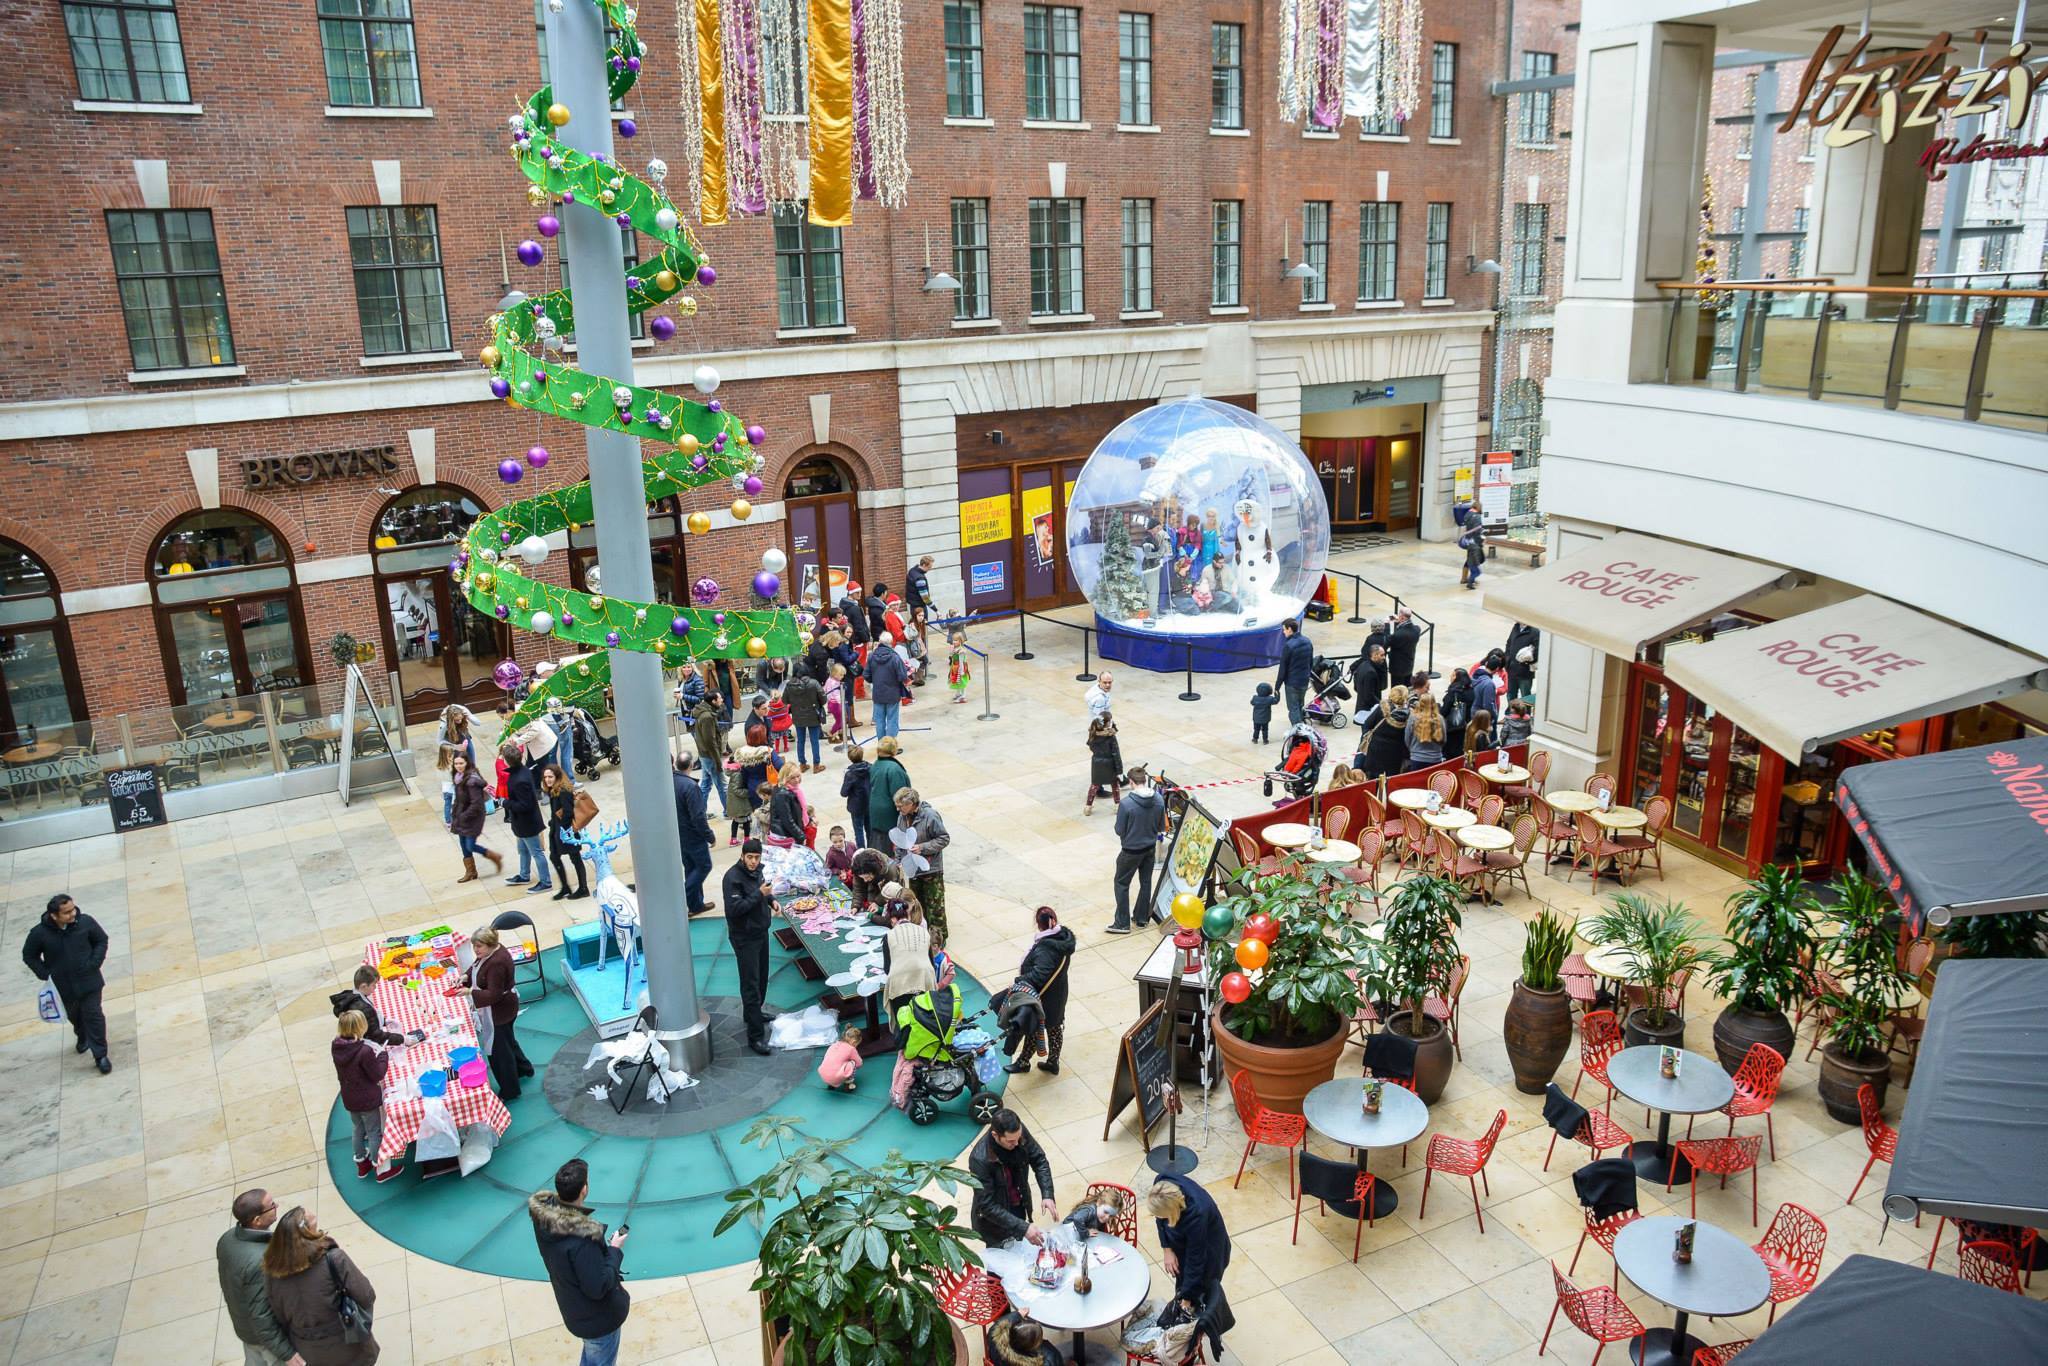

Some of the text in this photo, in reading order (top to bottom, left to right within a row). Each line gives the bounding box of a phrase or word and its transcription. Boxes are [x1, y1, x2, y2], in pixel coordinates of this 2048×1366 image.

[240, 445, 399, 490] BROWNS
[1558, 569, 1677, 610] ROUGE
[1757, 638, 1881, 699] ROUGE
[8, 756, 99, 784] BROWNS
[108, 770, 153, 788] Signature
[111, 780, 155, 797] COCKTAILS
[130, 807, 147, 819] £5
